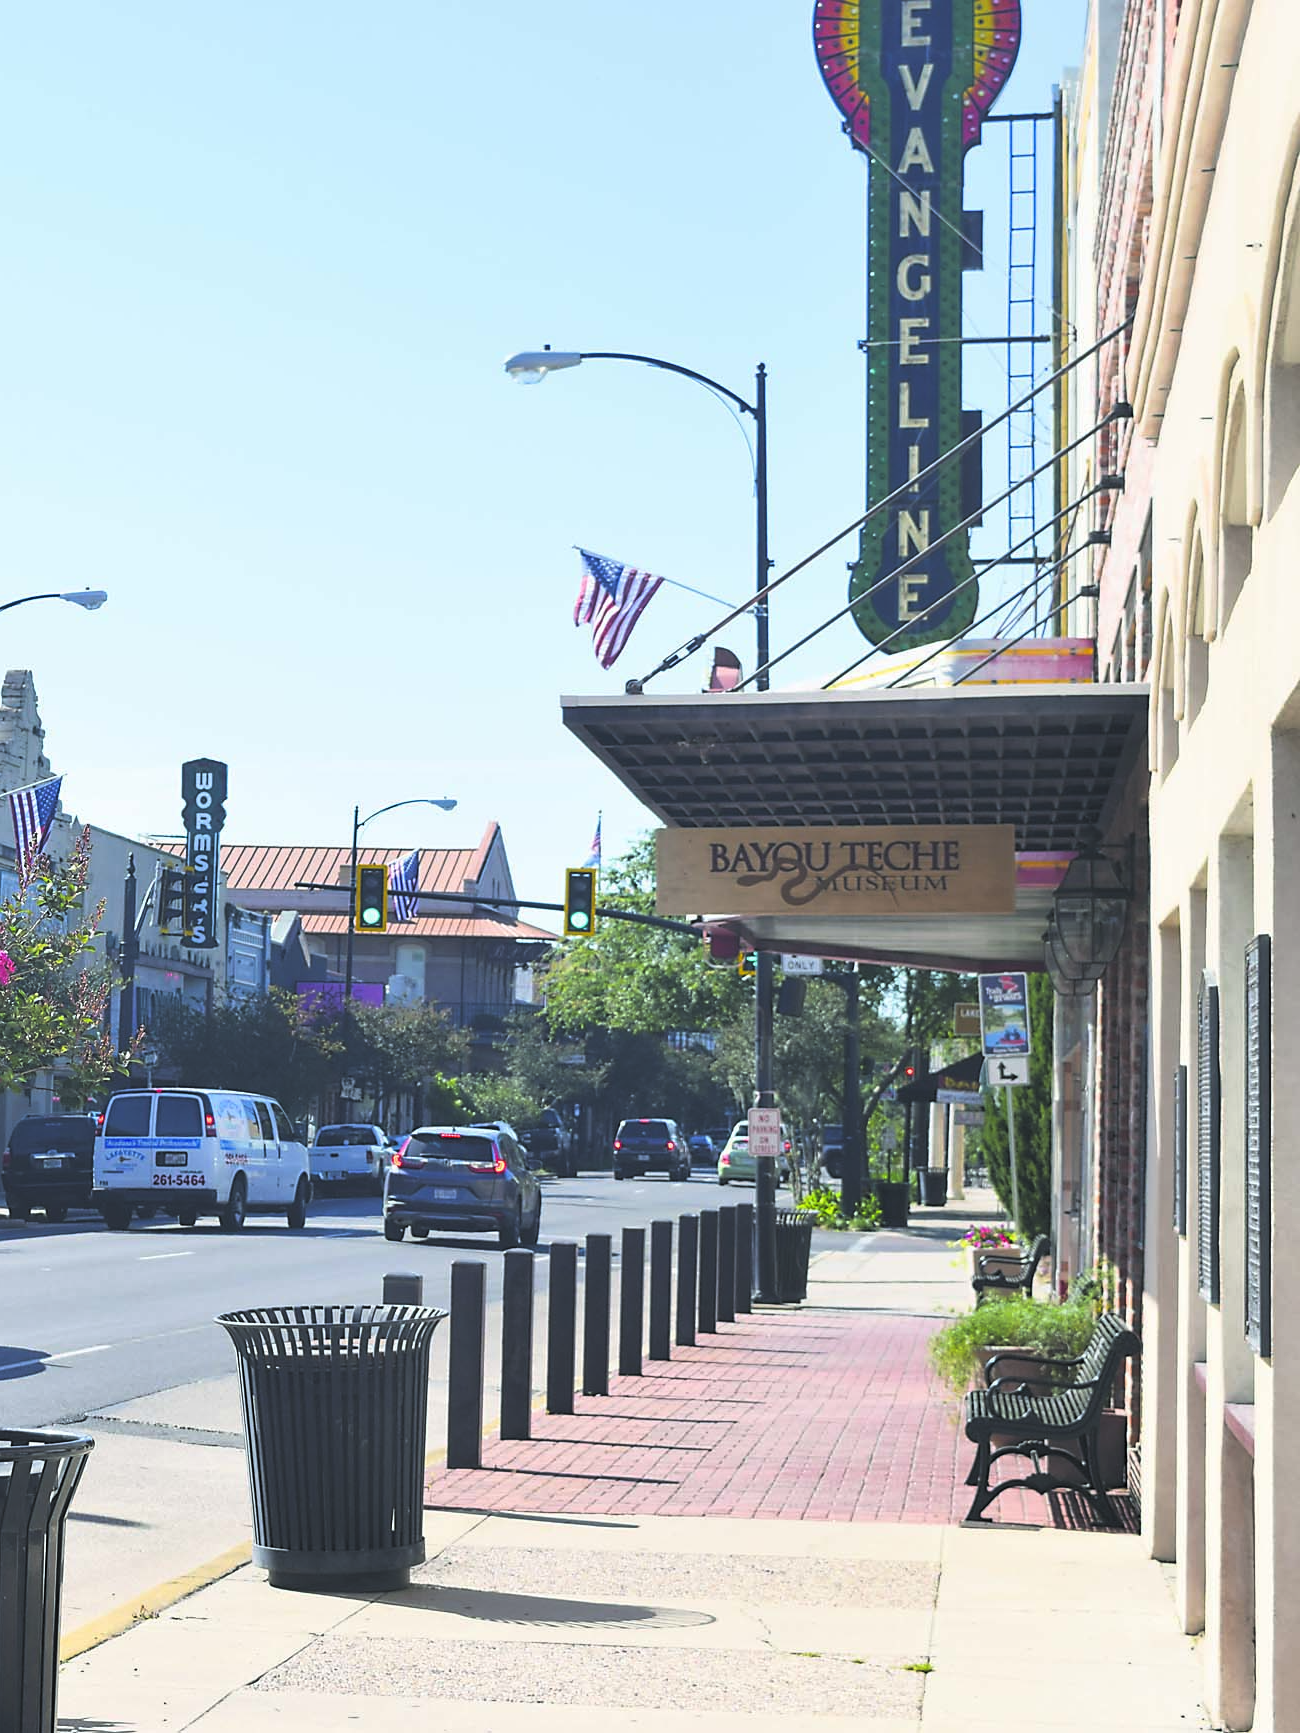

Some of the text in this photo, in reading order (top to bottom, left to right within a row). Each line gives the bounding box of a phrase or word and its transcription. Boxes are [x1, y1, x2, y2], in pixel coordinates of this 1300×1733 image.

[896, 0, 934, 620] EVANGELINE
[709, 841, 960, 873] BAYOU TECHE
[817, 876, 948, 892] MUSEUM
[788, 961, 815, 970] ONLY
[752, 1126, 779, 1134] PARKING
[153, 1174, 205, 1186] 261-5464
